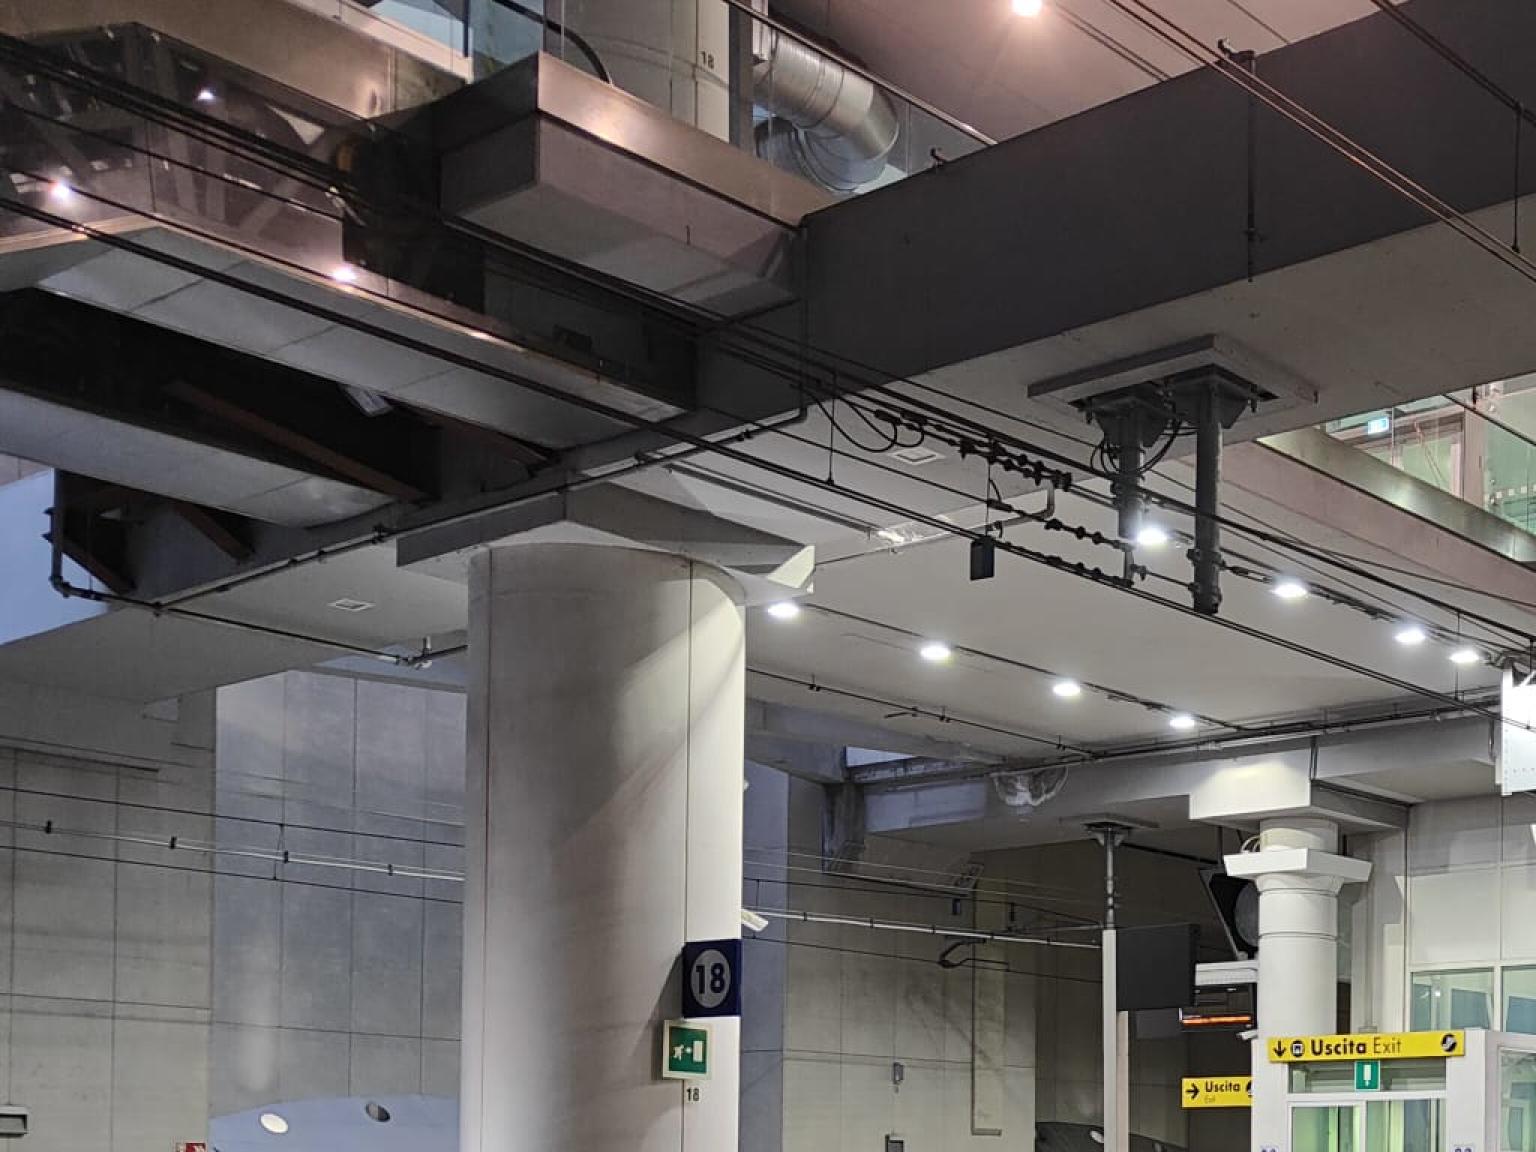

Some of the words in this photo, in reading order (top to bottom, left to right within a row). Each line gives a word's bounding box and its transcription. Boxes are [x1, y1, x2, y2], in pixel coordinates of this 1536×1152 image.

[695, 962, 726, 995] 18
[1310, 1038, 1367, 1056] Uscita
[1373, 1038, 1402, 1055] Exit
[1205, 1080, 1241, 1093] Uscita
[686, 1088, 700, 1102] 18
